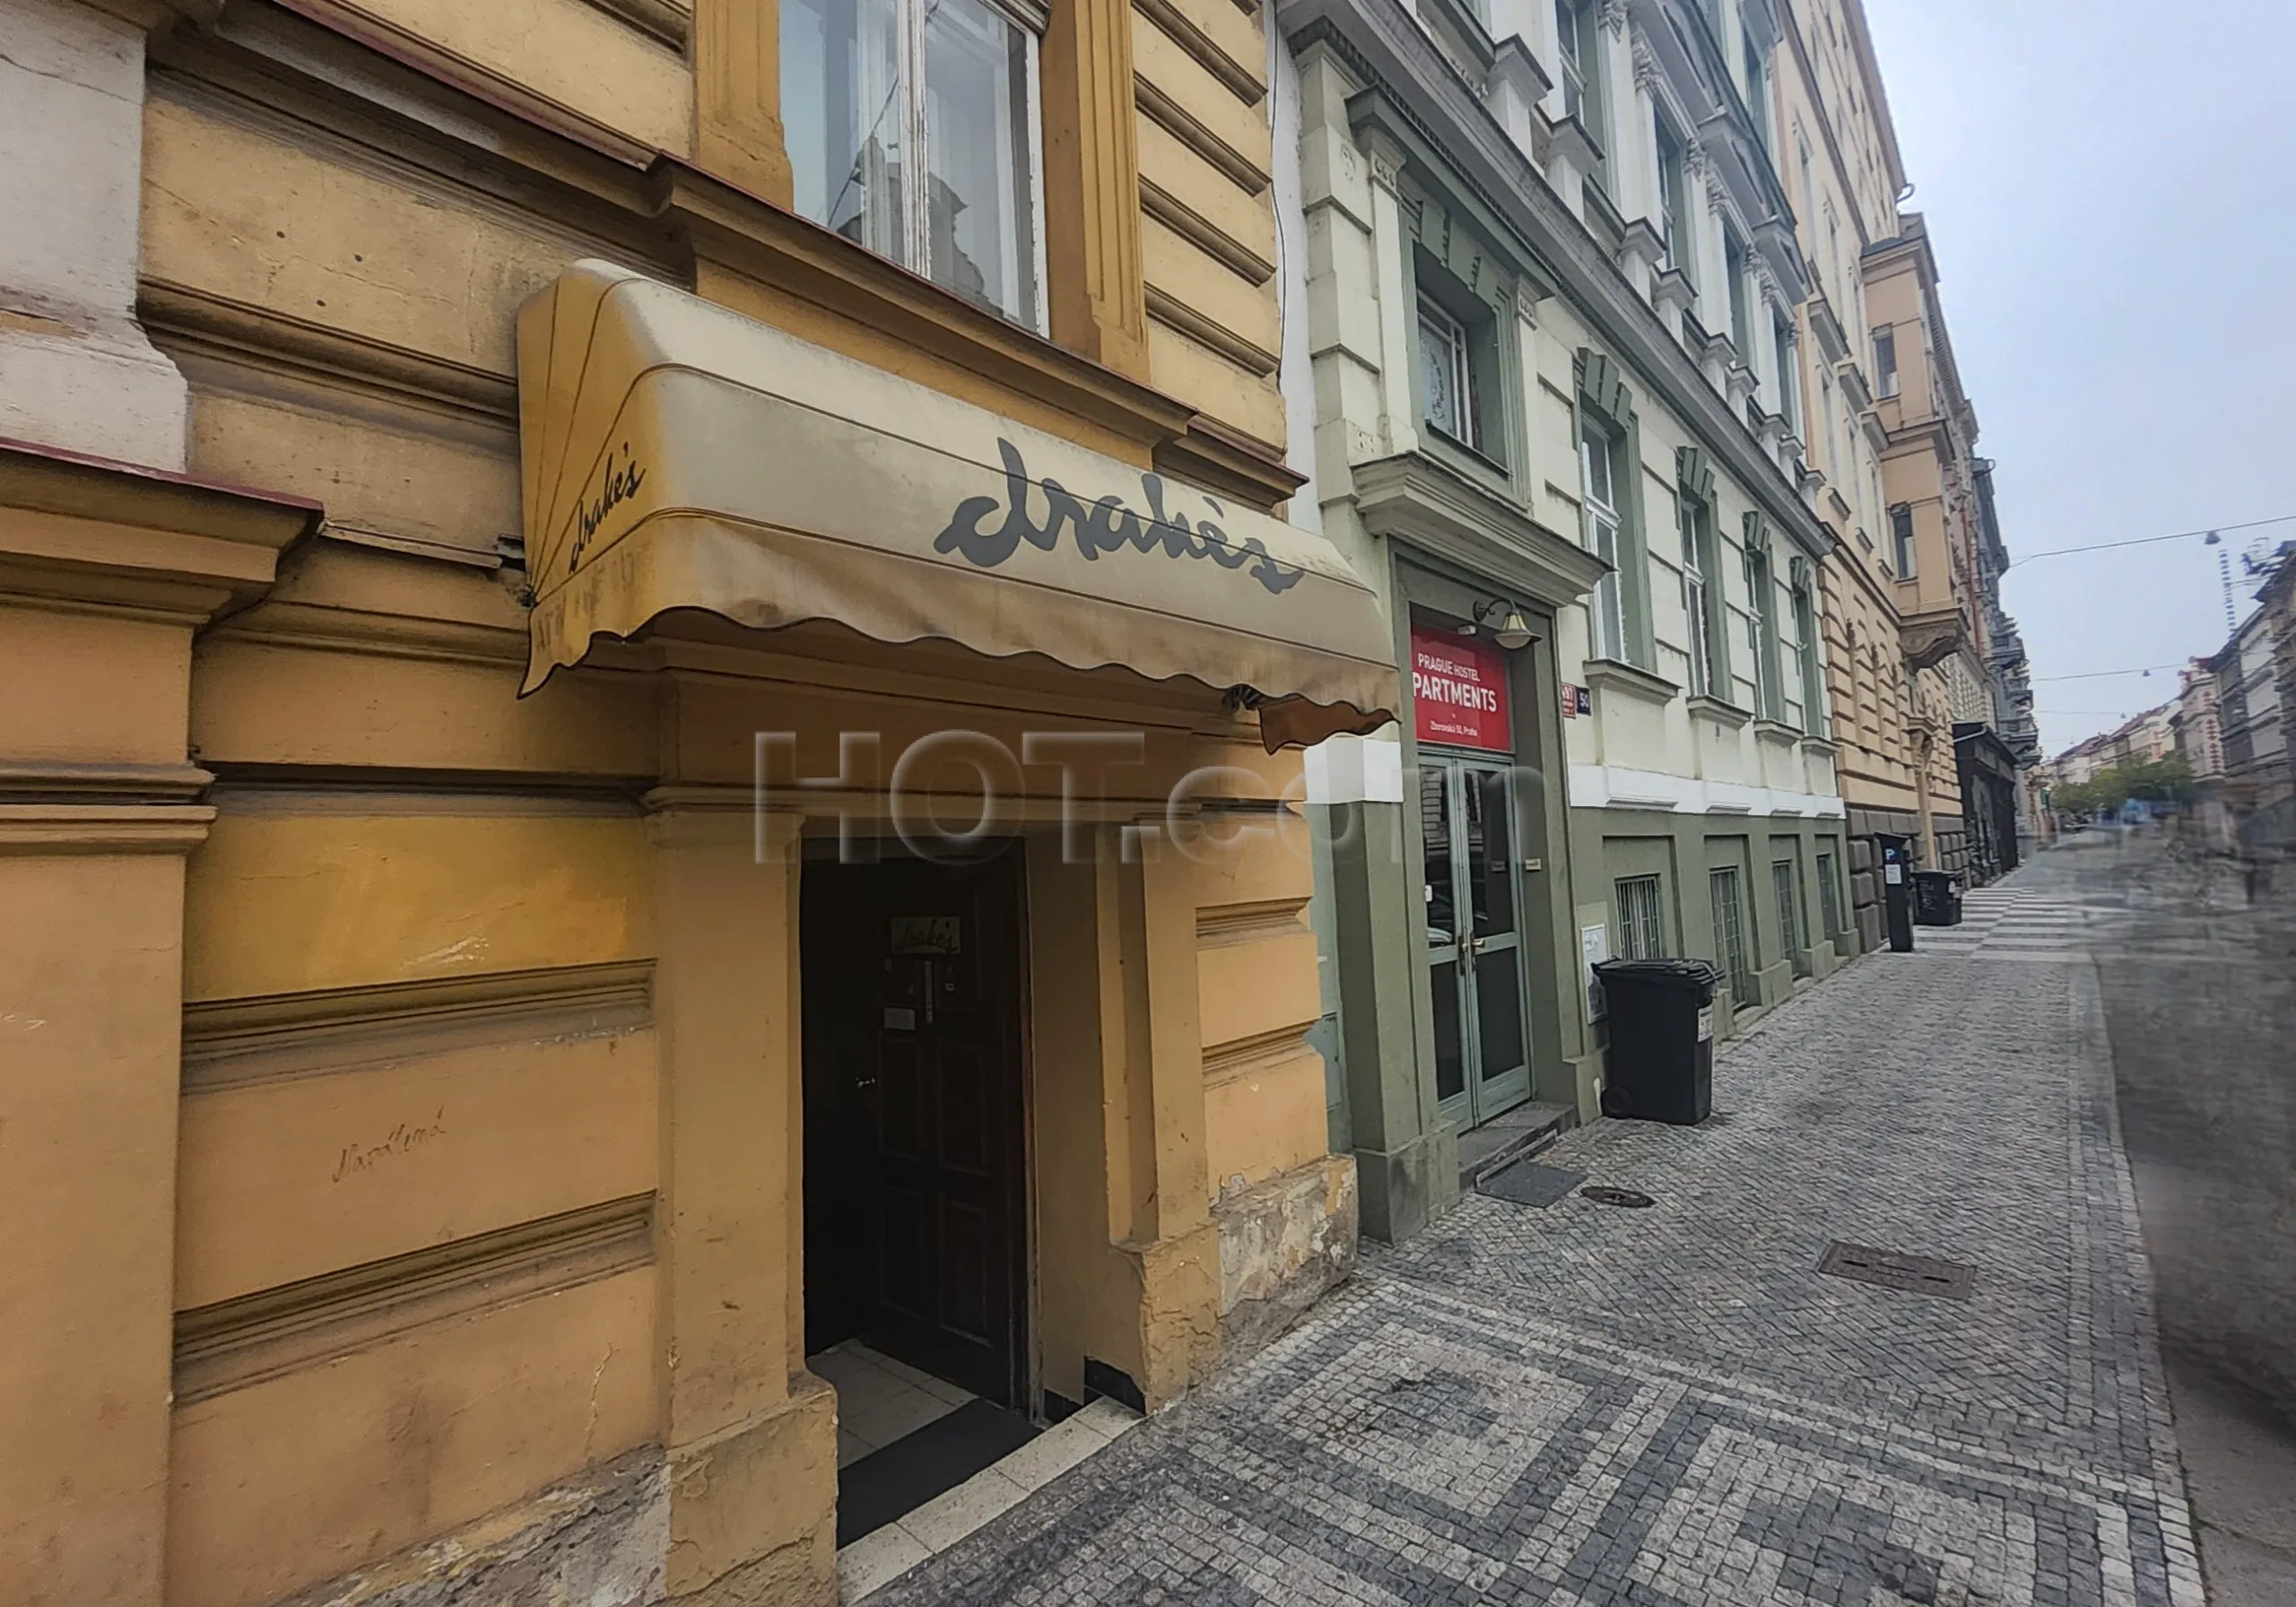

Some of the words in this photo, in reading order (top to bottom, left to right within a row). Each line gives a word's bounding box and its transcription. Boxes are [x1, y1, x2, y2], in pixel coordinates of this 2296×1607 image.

[569, 441, 646, 575] drake's
[1418, 652, 1453, 675] PRAGUE
[1453, 662, 1481, 682] HOSTEL
[1412, 672, 1498, 713] PARTMENTS
[1884, 847, 1895, 861] P
